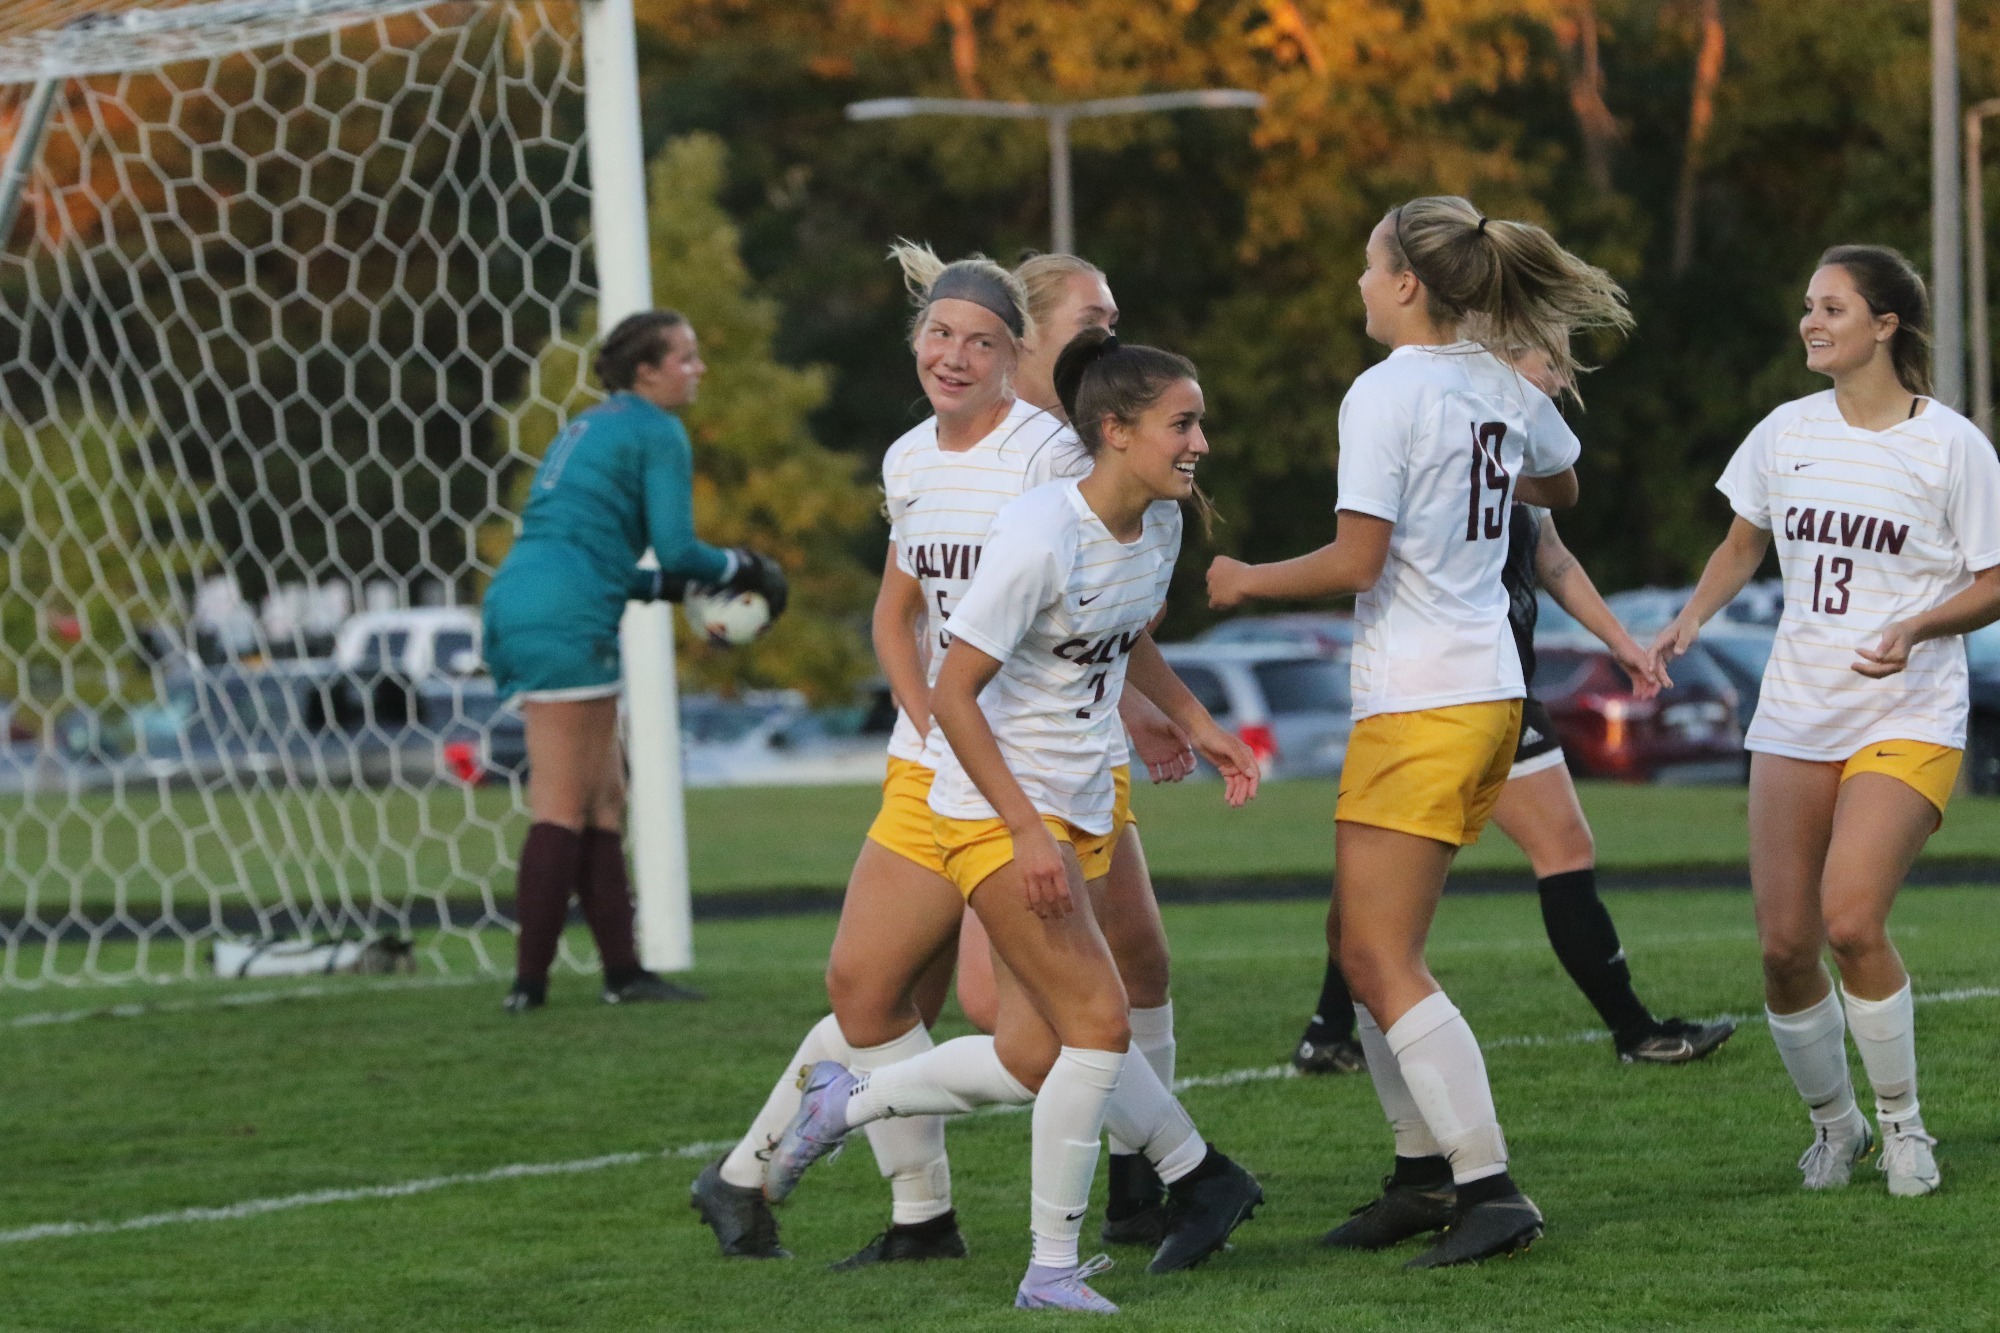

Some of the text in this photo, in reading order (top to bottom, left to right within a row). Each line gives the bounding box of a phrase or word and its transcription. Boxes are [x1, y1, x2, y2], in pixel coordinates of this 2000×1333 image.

[1465, 421, 1509, 541] 19
[1785, 506, 1910, 555] CALVIN
[908, 543, 982, 580] ALVI
[1812, 554, 1854, 615] 13
[1052, 629, 1141, 666] CALV
